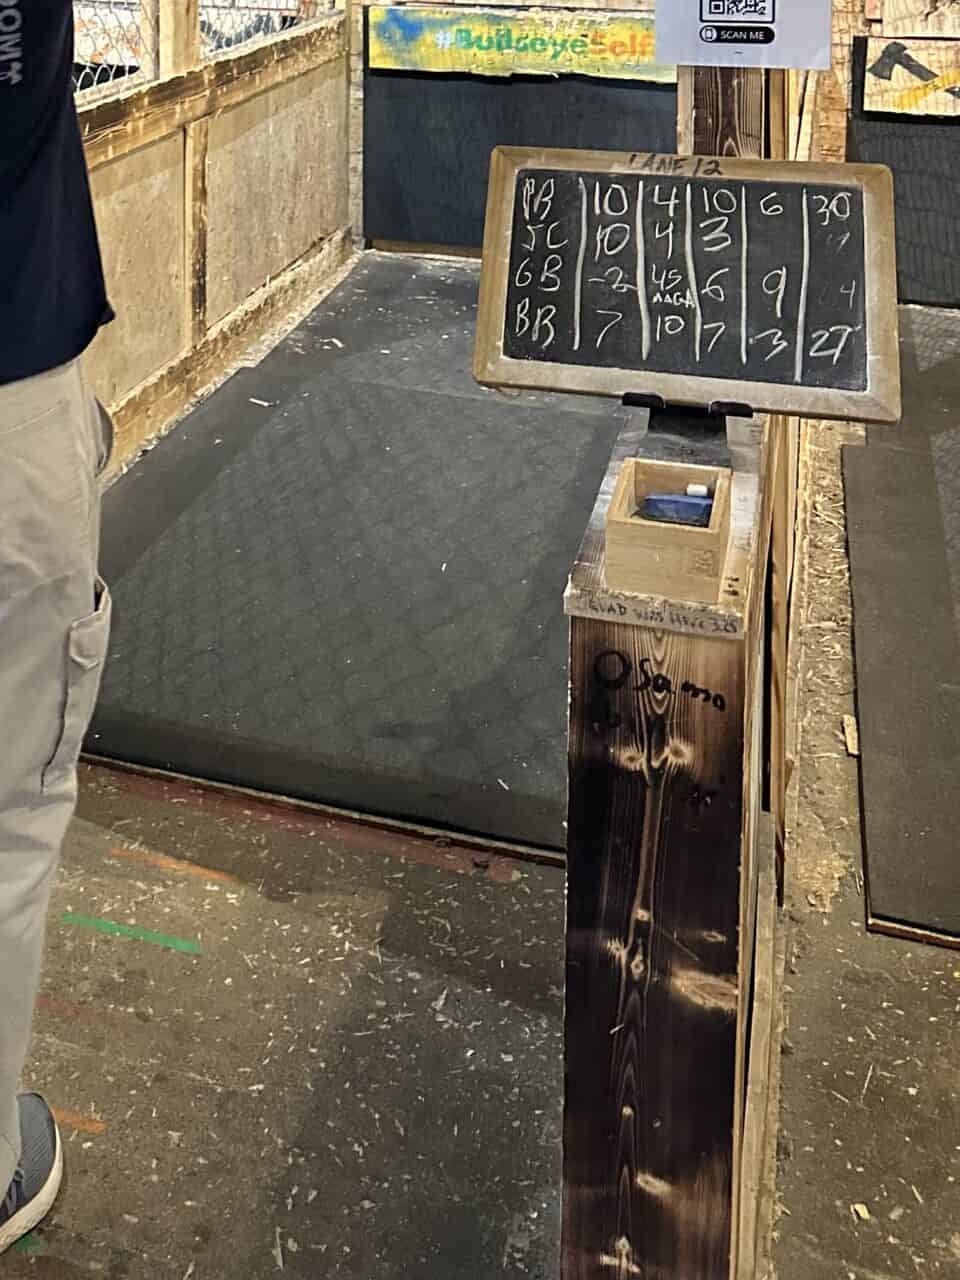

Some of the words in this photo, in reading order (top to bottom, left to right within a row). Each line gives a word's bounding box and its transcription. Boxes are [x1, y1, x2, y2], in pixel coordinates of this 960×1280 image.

[720, 30, 747, 40] SCAN
[749, 29, 765, 40] ME
[629, 152, 688, 174] LANE
[692, 157, 723, 177] 12
[592, 182, 630, 217] 10
[652, 183, 681, 217] 4
[702, 187, 737, 216] 10
[759, 191, 786, 216] 6
[812, 192, 852, 226] 30
[594, 222, 631, 262] 10
[654, 221, 675, 260] 4
[698, 216, 732, 252] 3
[701, 267, 731, 303] 6
[761, 265, 788, 319] 9
[594, 309, 625, 350] 7
[654, 313, 685, 343] 10
[702, 321, 727, 353] 7
[808, 323, 861, 366] 27
